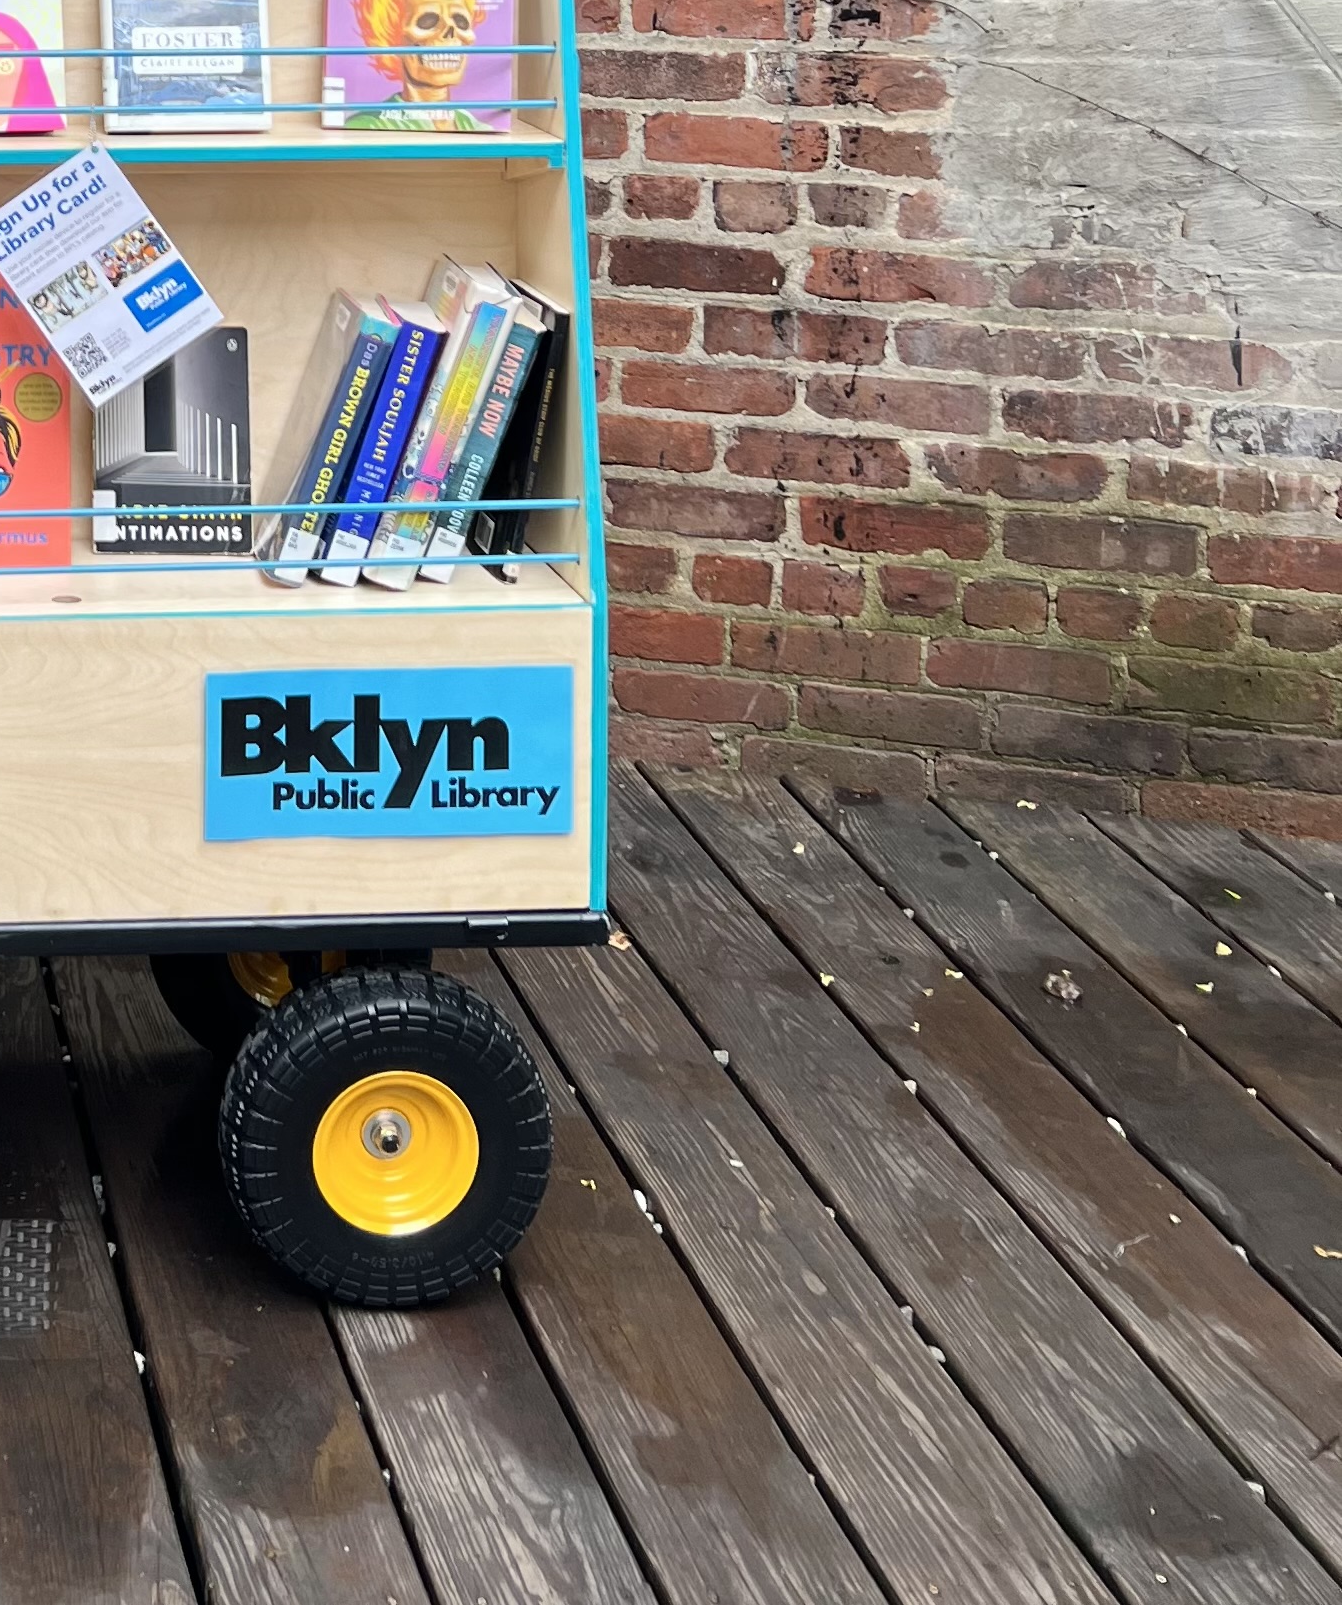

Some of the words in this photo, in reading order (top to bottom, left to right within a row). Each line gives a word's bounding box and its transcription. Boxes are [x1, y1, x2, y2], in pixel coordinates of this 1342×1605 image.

[141, 58, 181, 67] CLAIRE
[188, 58, 234, 67] KEEGAN
[142, 31, 233, 47] FOSTER
[21, 190, 52, 212] Up
[52, 169, 79, 193] for
[82, 160, 95, 173] a
[57, 174, 107, 214] Card!
[397, 329, 424, 386] SISTER
[491, 343, 525, 398] MAYBE
[338, 366, 371, 430] BROWN
[479, 397, 507, 440] NOW
[324, 428, 348, 465] GIRL
[372, 387, 406, 463] SOULJAH
[300, 467, 334, 534] GHOTE
[457, 453, 485, 502] COLLEEN
[115, 525, 243, 541] NTIMATIONS
[221, 694, 509, 808] Bklyn
[273, 778, 375, 809] Public
[431, 777, 560, 815] Library
